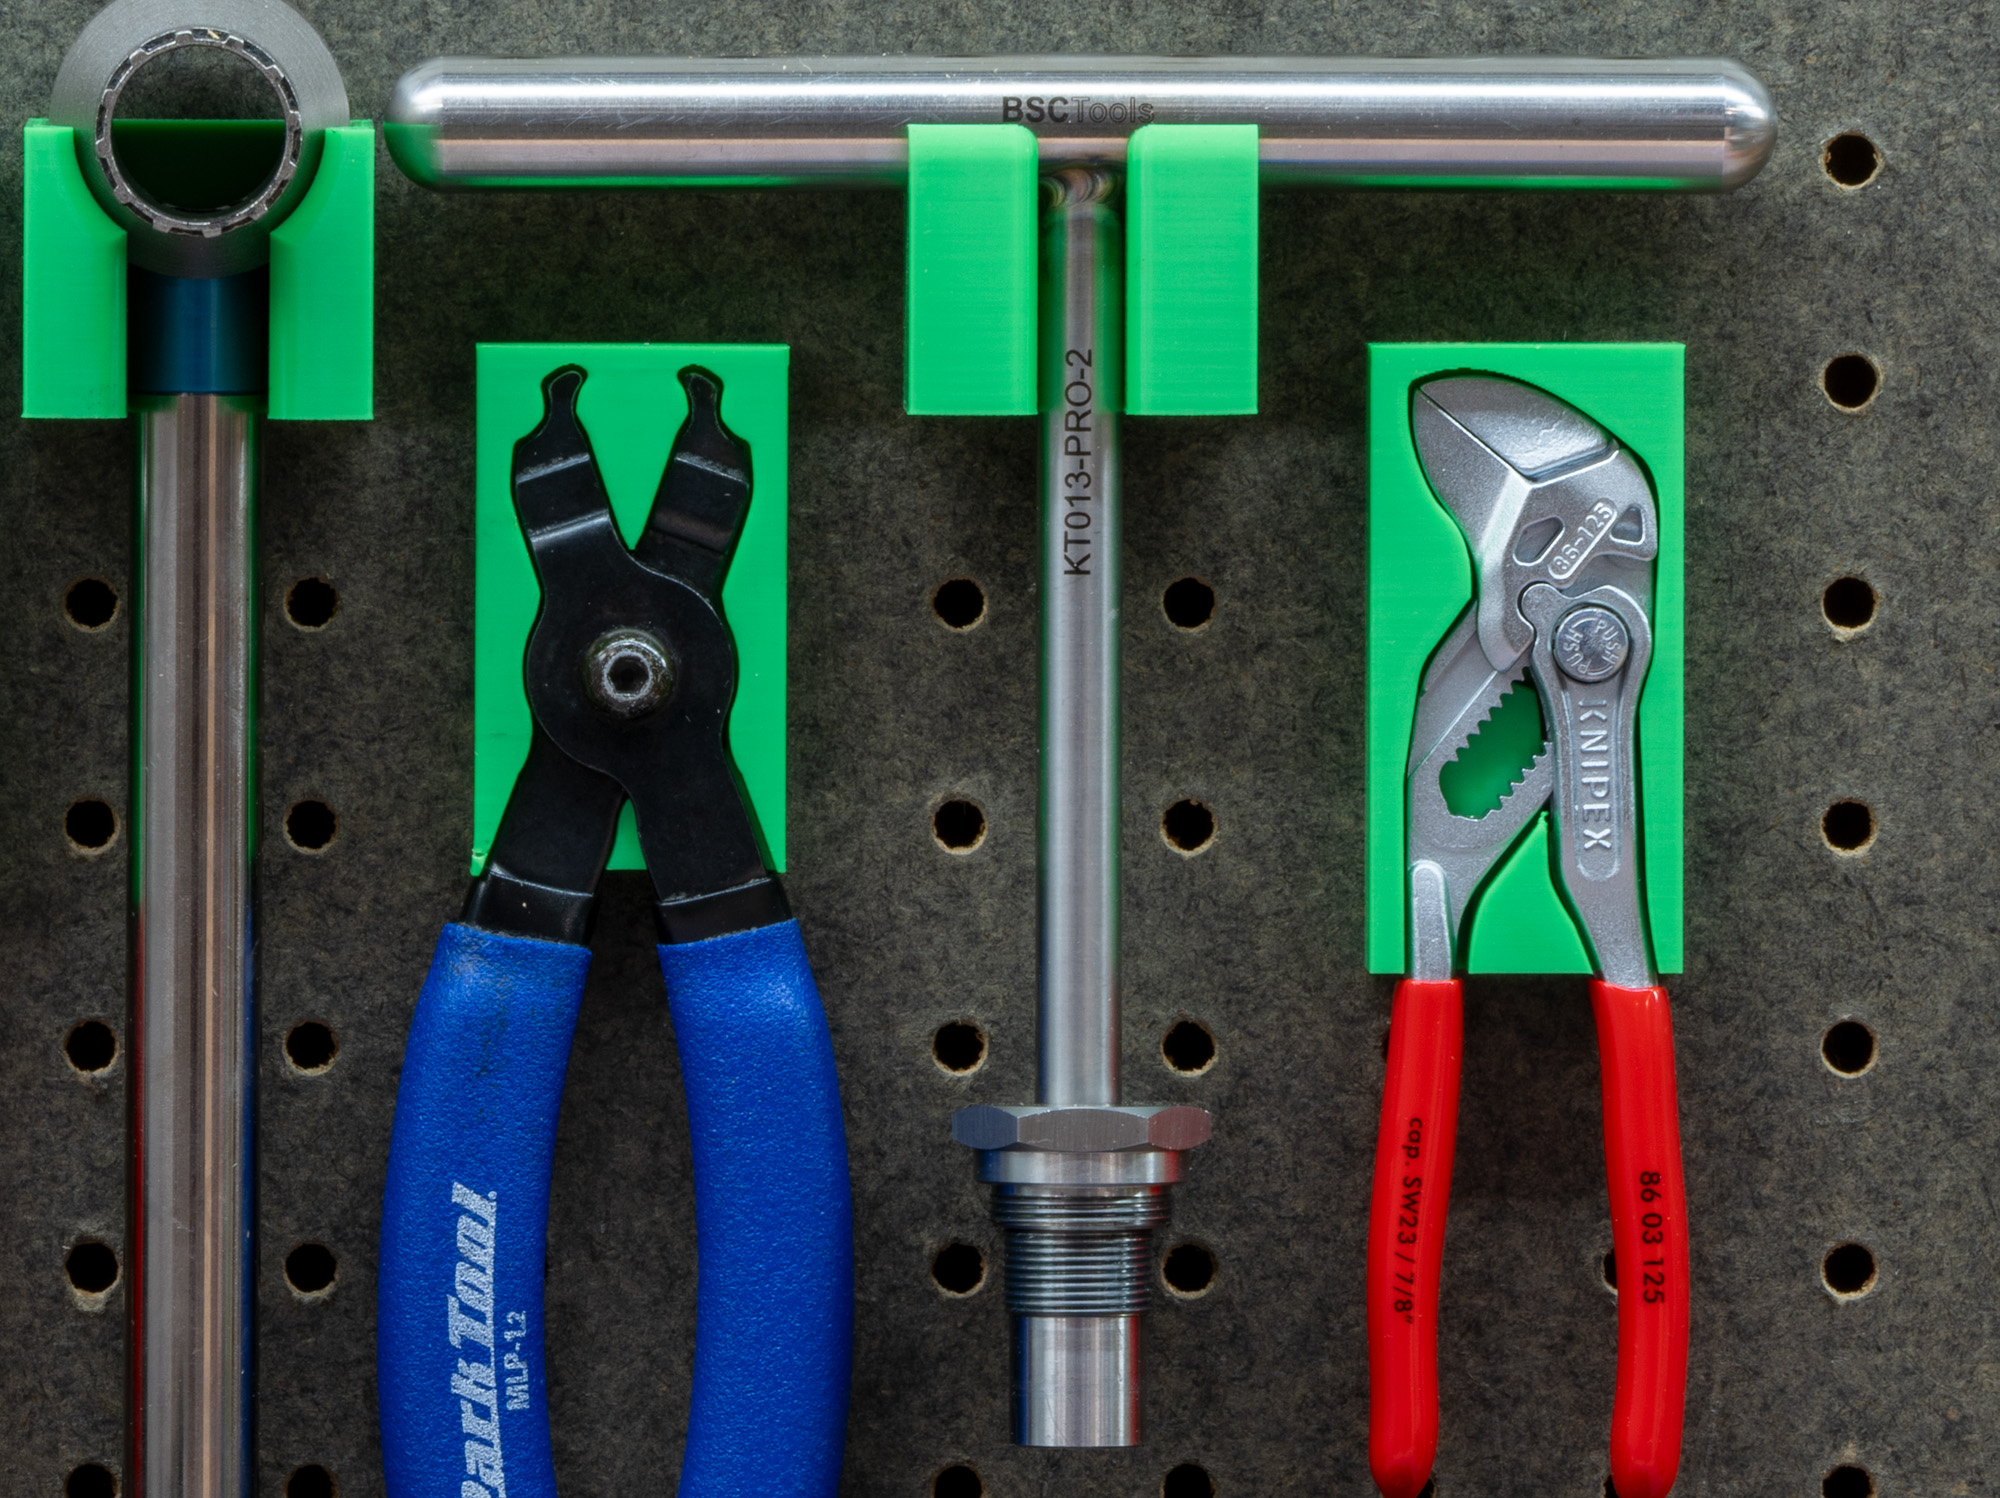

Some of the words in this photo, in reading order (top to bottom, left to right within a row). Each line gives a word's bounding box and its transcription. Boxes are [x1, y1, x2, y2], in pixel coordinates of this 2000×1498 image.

[1002, 96, 1155, 124] BSCTools
[1064, 348, 1093, 576] KT013-PRO-2
[1552, 502, 1613, 571] 86-125
[1563, 627, 1593, 675] PUSH
[1593, 618, 1622, 670] PUSH
[1578, 699, 1612, 849] KNIPEX
[1401, 1117, 1423, 1167] cap.
[1397, 1176, 1422, 1246] SW23
[1639, 1170, 1662, 1204] 86
[1641, 1212, 1664, 1246] 03
[1642, 1258, 1665, 1305] 125
